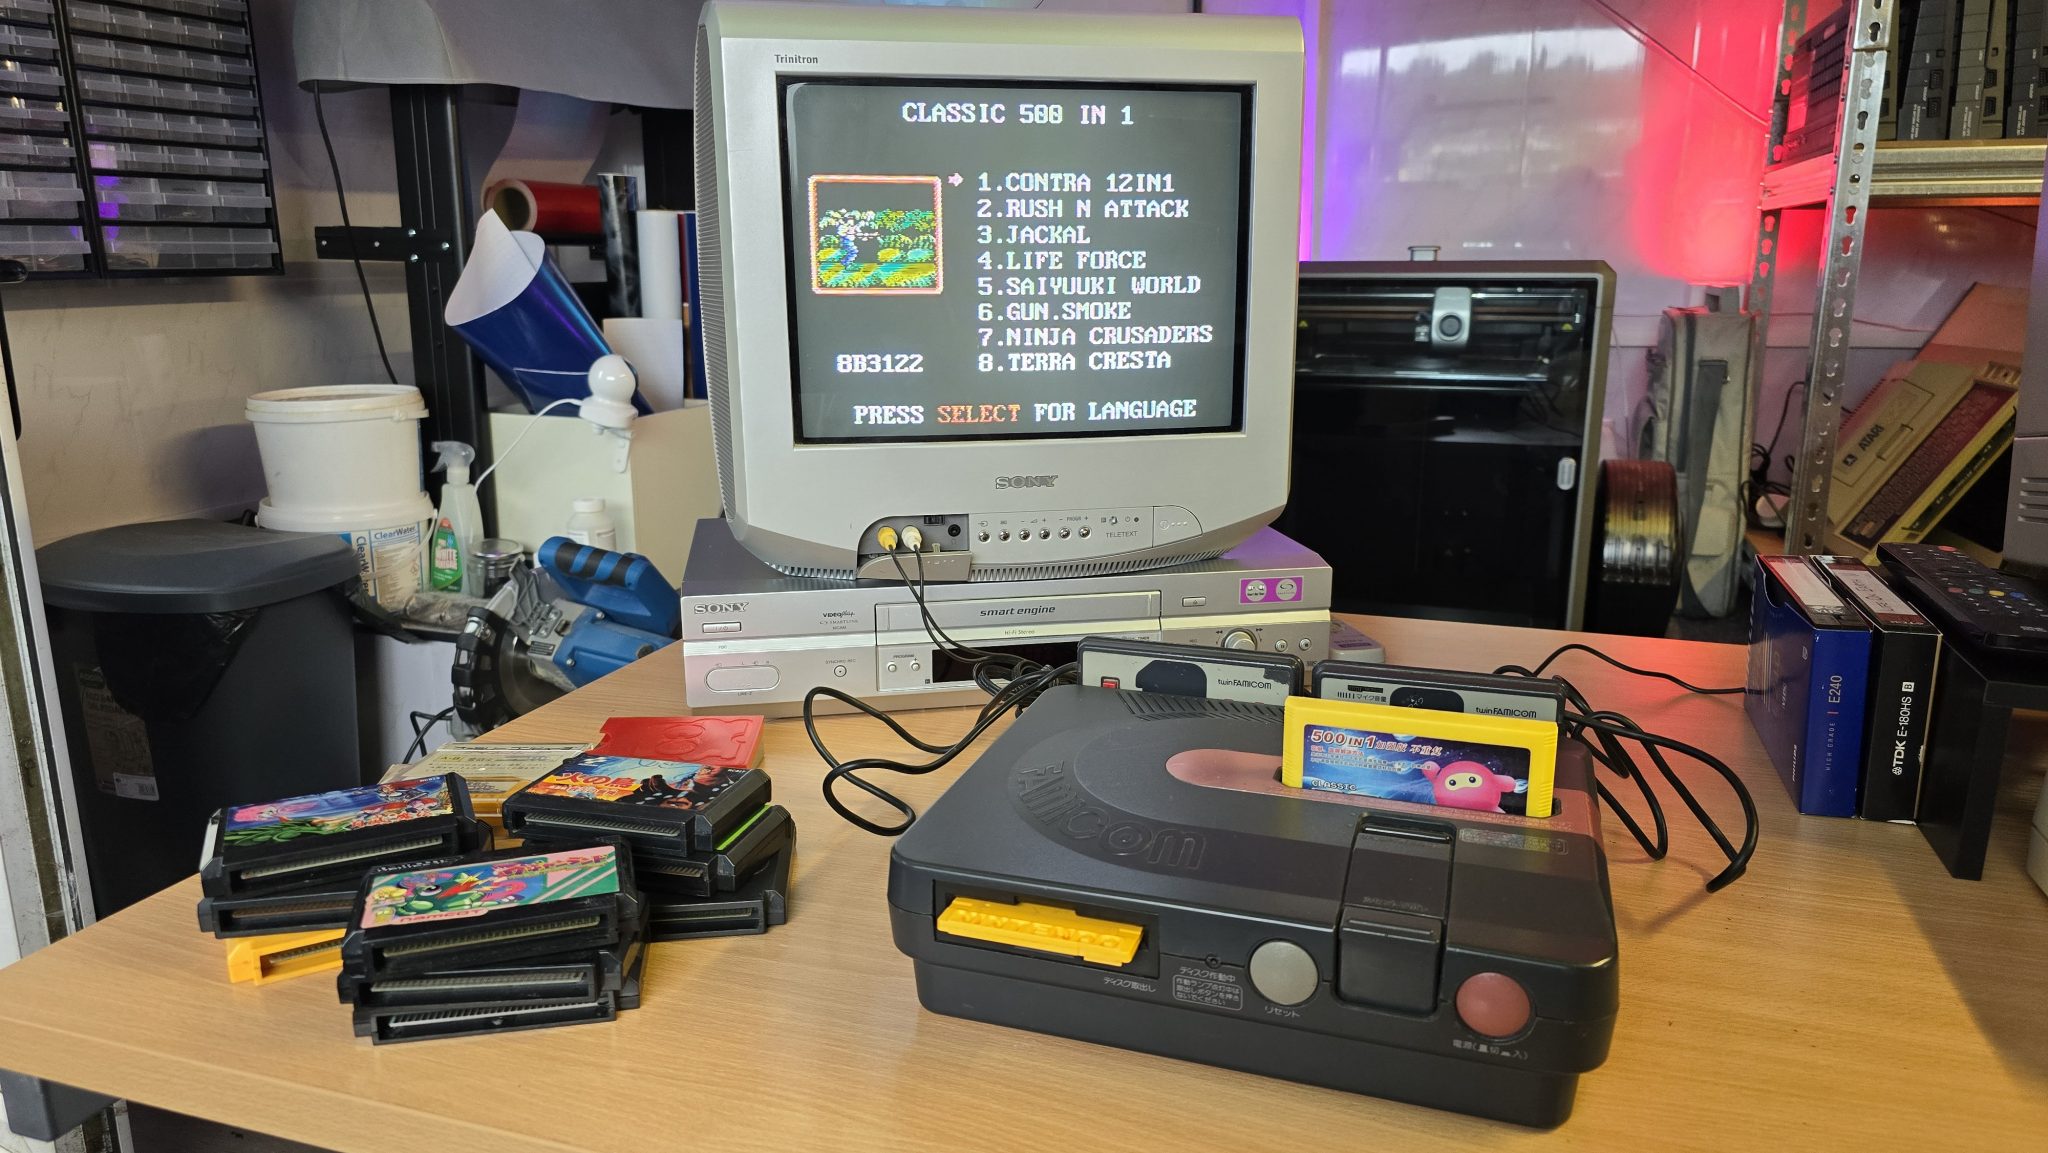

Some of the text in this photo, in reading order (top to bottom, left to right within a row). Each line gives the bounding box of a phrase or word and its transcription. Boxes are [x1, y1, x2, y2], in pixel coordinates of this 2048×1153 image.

[774, 54, 818, 65] Trinitron
[902, 102, 1134, 125] CLASSIC 500 IN 1
[977, 172, 1175, 193] 1.CONTRA 12IN1
[977, 199, 1189, 218] 2.RUSH N ATTACK
[977, 225, 1091, 244] 3.JACKAL
[977, 250, 1147, 270] 4.LIFE FORCE
[977, 275, 1201, 296] 5.SAIYUUKI WORLD
[978, 302, 1132, 321] 6.GUN.SMOKE
[978, 324, 1214, 347] 7.NINJA CRUSADERS
[836, 354, 924, 373] 8B3122
[978, 350, 1172, 372] 8.TERRA CRESTA
[853, 399, 1197, 425] PRESS SELECT FOR LANGUAGE
[1858, 424, 1885, 451] ATARI
[995, 475, 1058, 489] SONY
[374, 526, 416, 540] ClearWater
[1105, 530, 1138, 538] TELETEXT
[694, 602, 749, 614] SONY
[980, 605, 1056, 617] smart engine
[1828, 675, 1843, 703] E240
[1897, 696, 1913, 738] E-180HS
[1828, 722, 1836, 749] GRADE
[1893, 740, 1906, 768] TDK
[1311, 779, 1358, 791] CLASSIC
[954, 909, 1124, 948] NINTENDO
[1264, 1004, 1300, 1018] リセット
